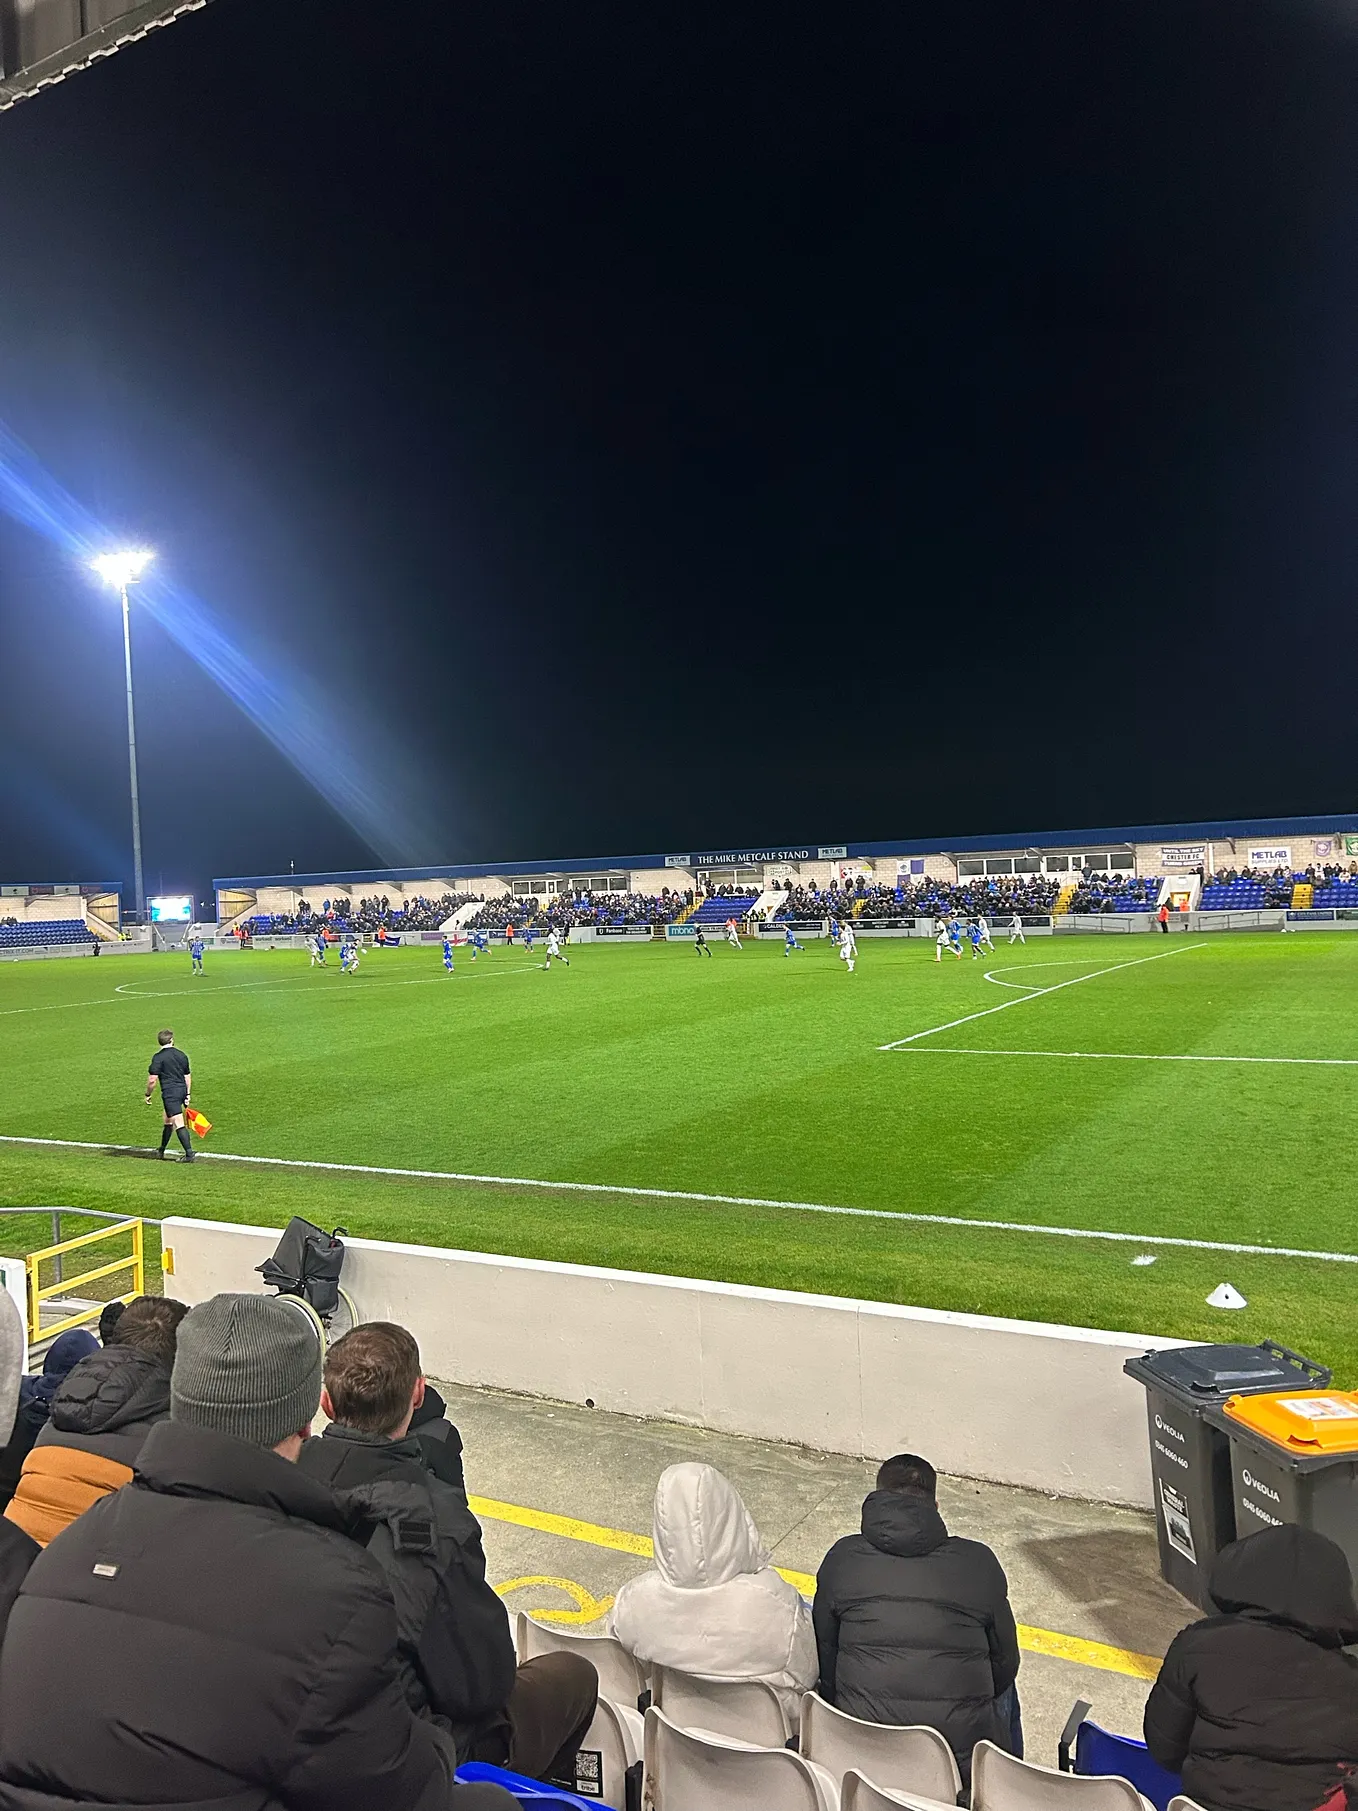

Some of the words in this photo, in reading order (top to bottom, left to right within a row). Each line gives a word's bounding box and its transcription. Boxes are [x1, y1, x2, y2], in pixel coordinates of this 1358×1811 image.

[698, 855, 714, 864] THE
[715, 854, 736, 863] MIKE
[737, 852, 776, 862] METCALF
[778, 850, 809, 860] STAND
[1251, 850, 1287, 859] METLAB
[1162, 1421, 1185, 1443] VEOLIA
[1165, 1447, 1178, 1462] 6060
[1178, 1456, 1189, 1469] 460
[1251, 1477, 1281, 1503] VEOLIA
[1255, 1506, 1271, 1524] 6060
